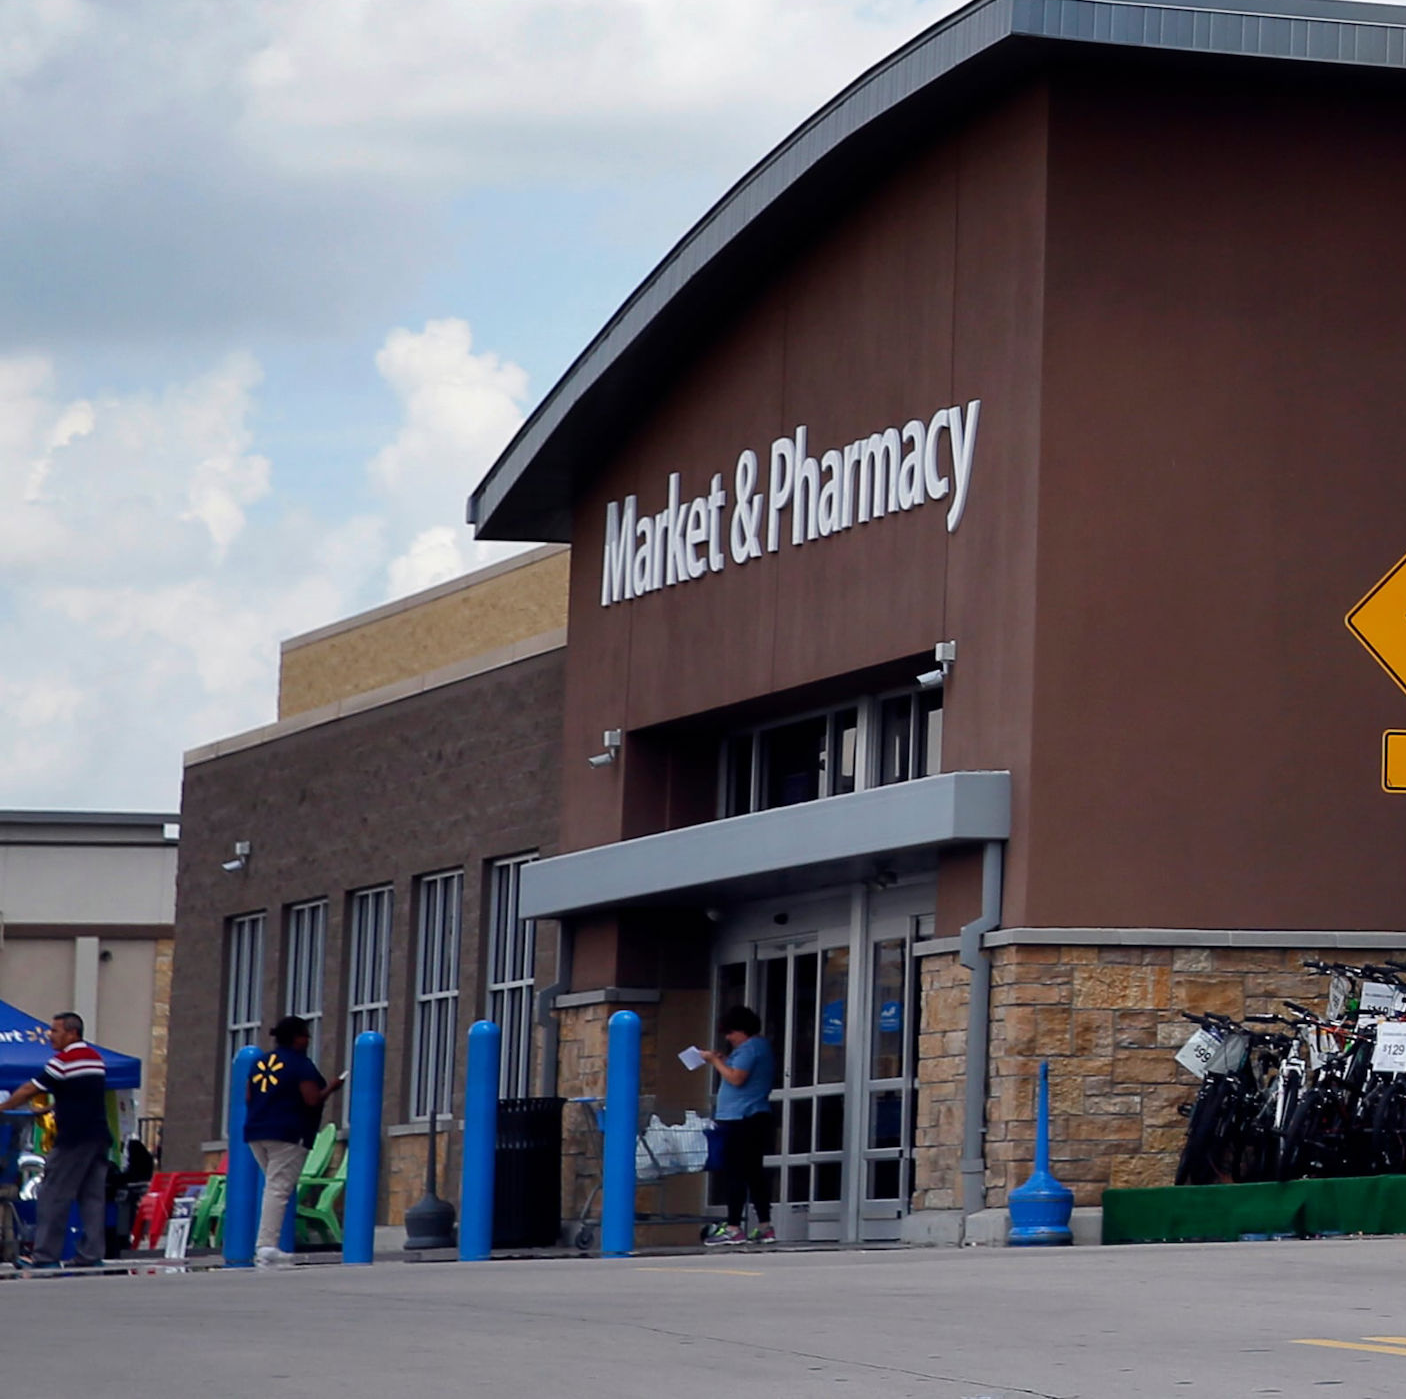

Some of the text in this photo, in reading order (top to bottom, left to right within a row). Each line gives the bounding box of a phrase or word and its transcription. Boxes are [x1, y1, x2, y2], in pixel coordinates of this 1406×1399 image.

[601, 399, 981, 607] Market & Pharmacy
[1382, 1044, 1405, 1056] $129
